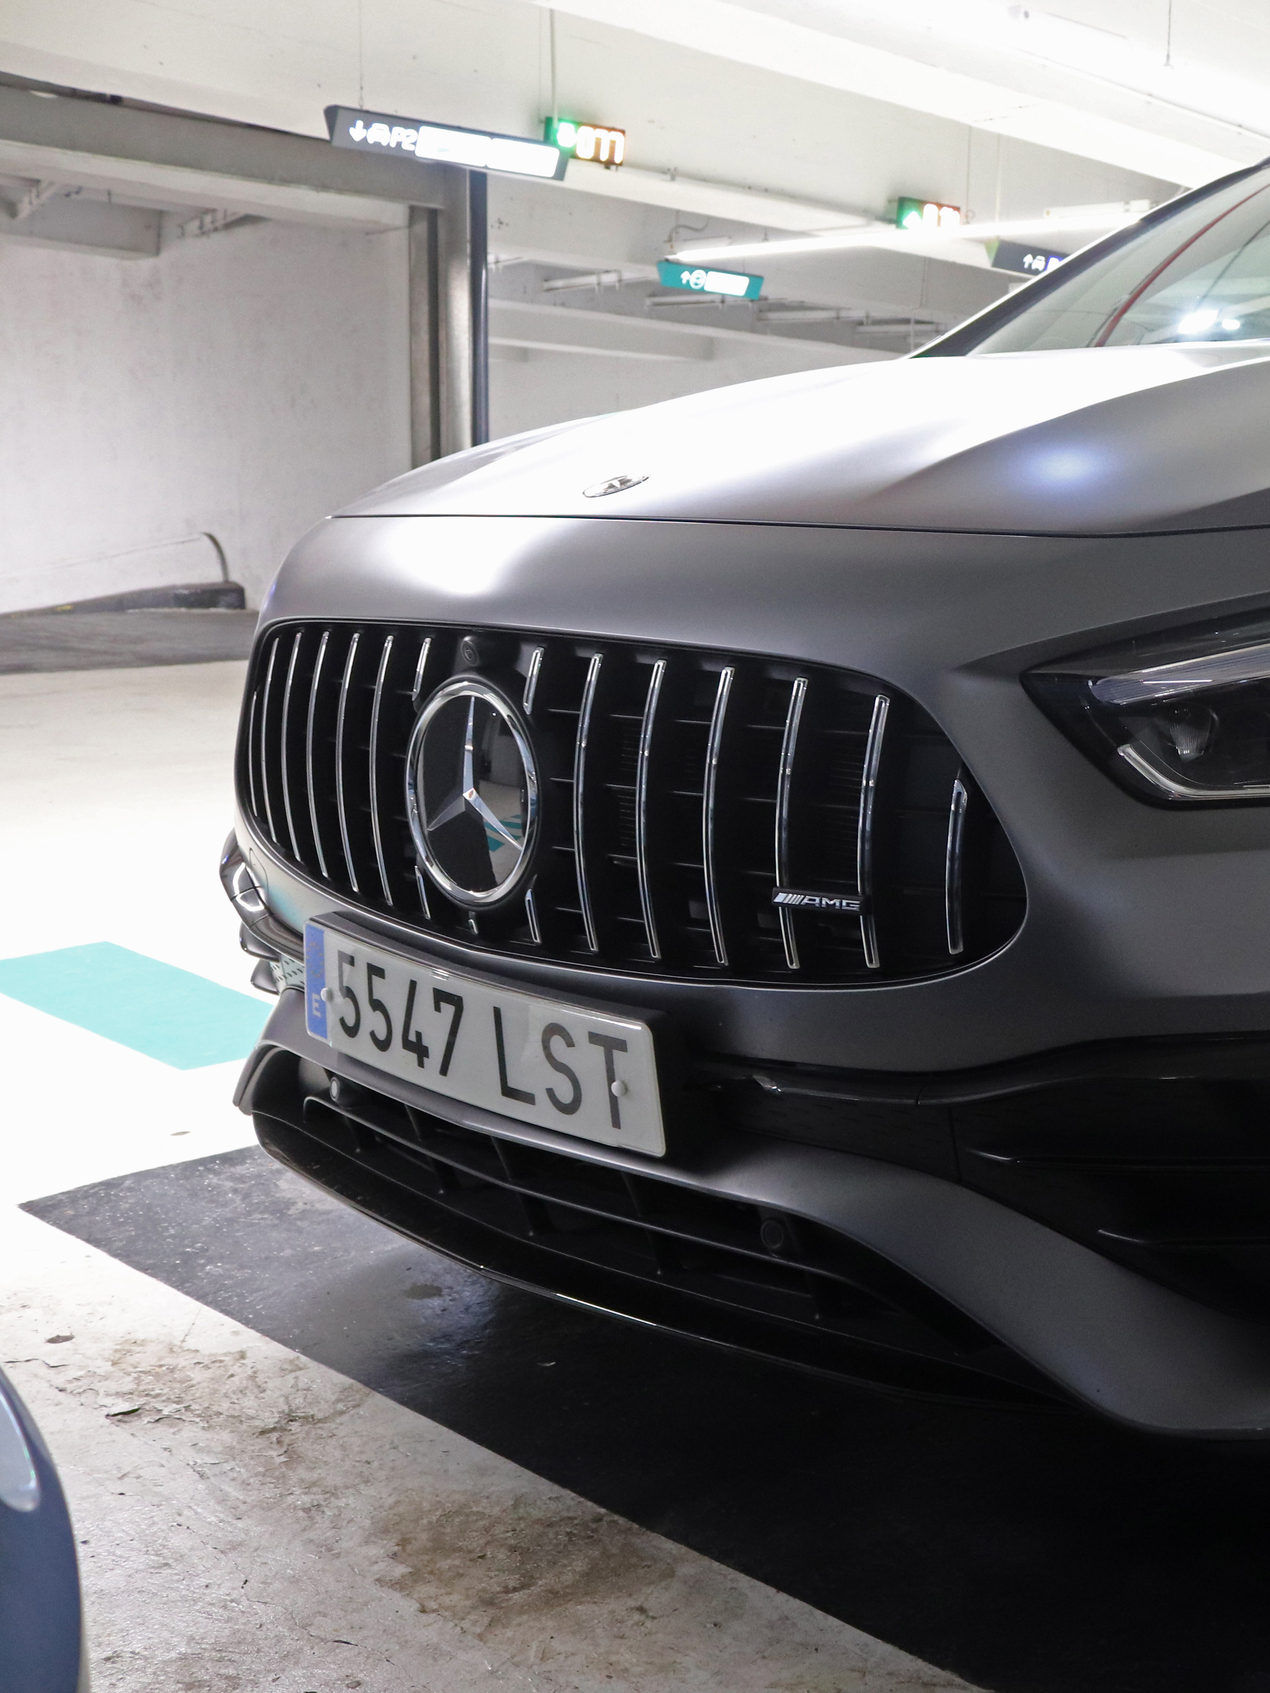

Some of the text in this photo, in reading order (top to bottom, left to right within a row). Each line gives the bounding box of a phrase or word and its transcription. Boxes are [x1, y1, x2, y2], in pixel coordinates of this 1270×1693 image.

[800, 895, 860, 912] AMG
[311, 992, 322, 1018] E
[337, 949, 628, 1130] 5547 LST
